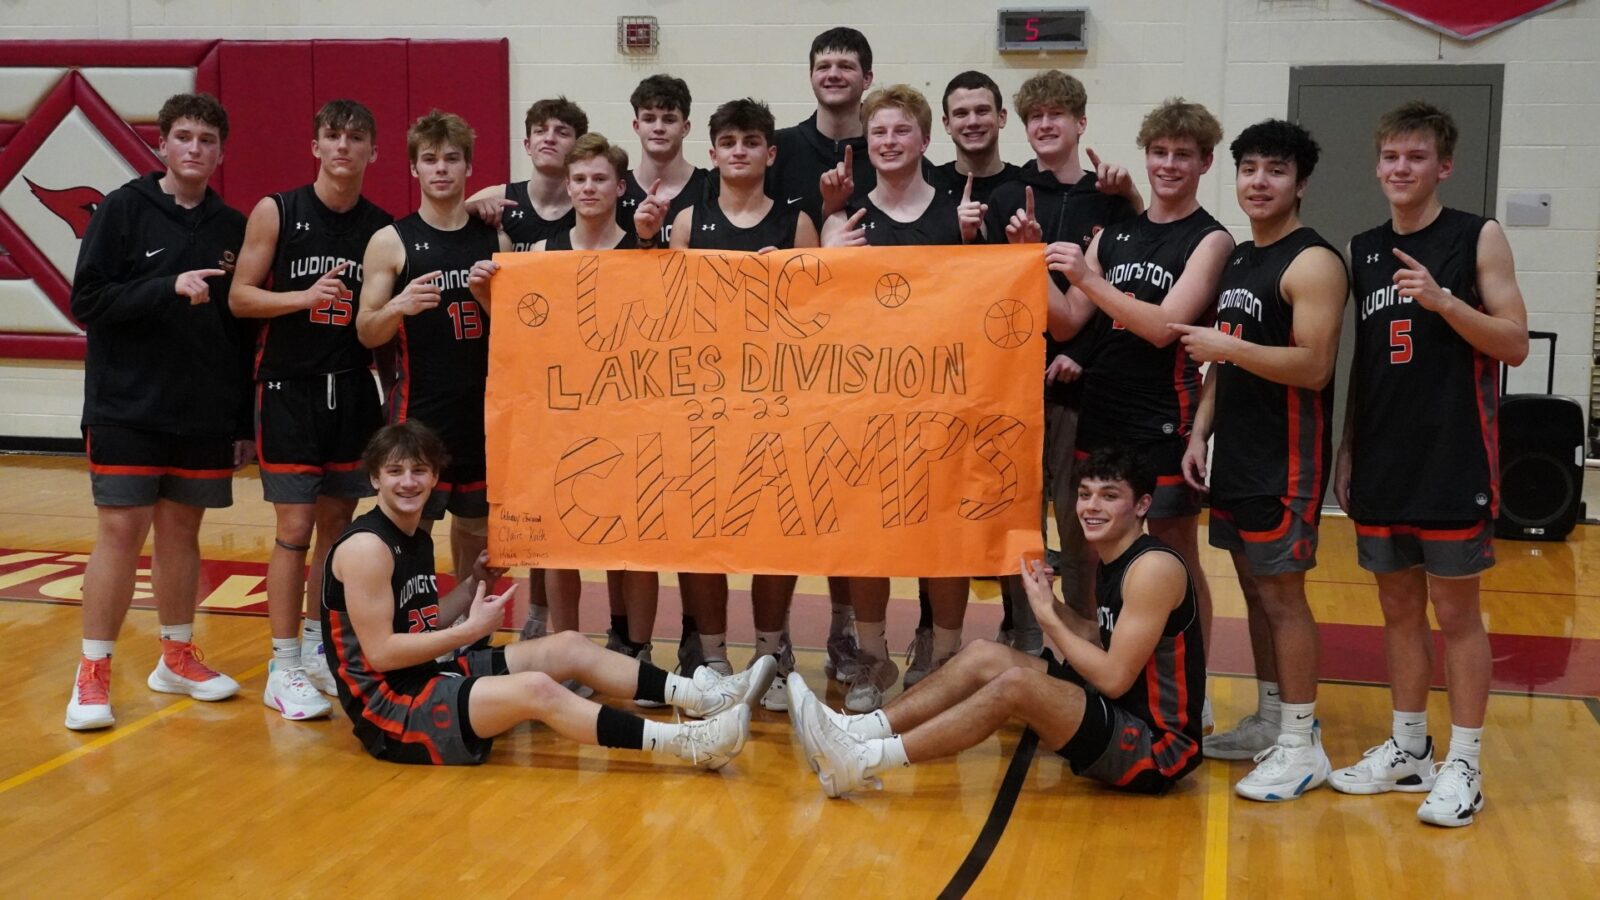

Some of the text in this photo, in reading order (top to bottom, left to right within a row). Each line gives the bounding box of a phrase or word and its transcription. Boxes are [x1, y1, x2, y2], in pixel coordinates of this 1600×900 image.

[1025, 17, 1039, 41] 5
[309, 289, 353, 326] 25
[447, 301, 483, 340] 13
[576, 251, 833, 352] WMC
[1389, 318, 1413, 364] 5
[547, 342, 967, 411] LAKES DIVISION
[688, 398, 791, 422] 22-23
[553, 410, 1028, 546] CHAMPS
